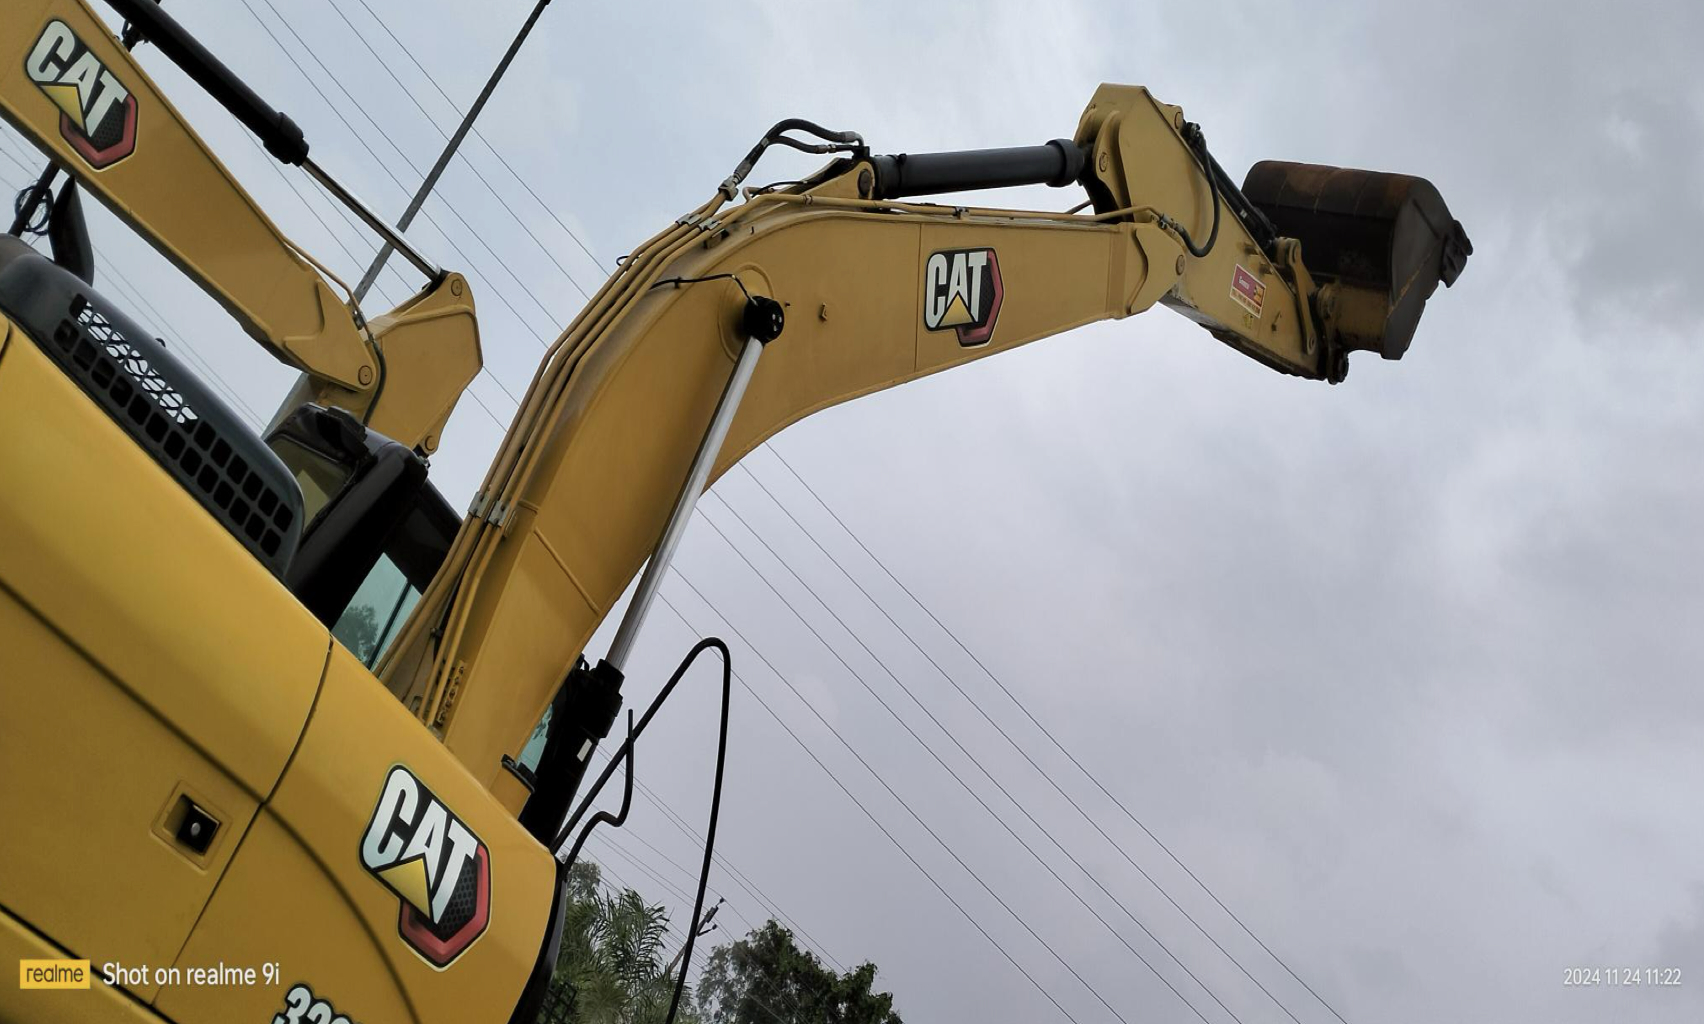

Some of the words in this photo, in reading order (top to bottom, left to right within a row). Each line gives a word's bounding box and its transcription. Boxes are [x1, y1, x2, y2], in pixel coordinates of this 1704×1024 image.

[26, 20, 129, 138] CAT
[925, 250, 988, 328] CAT
[363, 769, 478, 924] CAT
